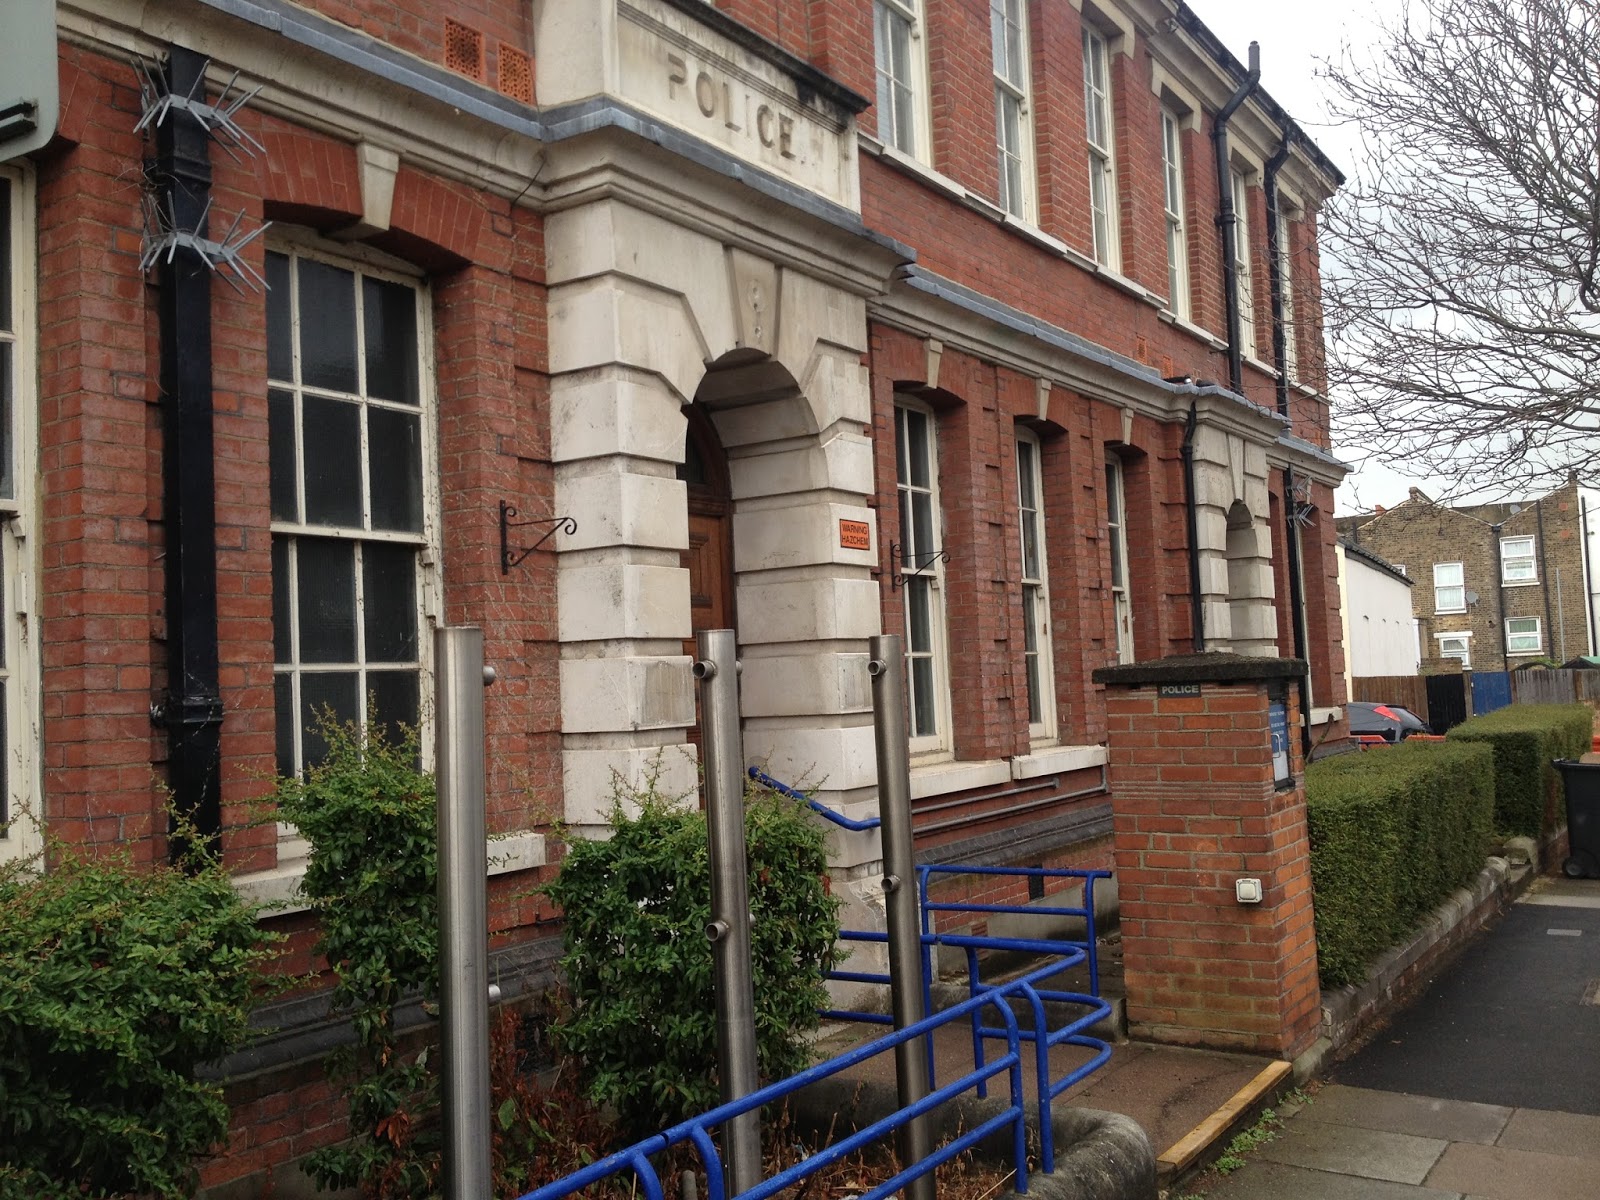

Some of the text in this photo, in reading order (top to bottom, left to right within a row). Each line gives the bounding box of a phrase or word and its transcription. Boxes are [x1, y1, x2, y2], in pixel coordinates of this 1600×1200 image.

[667, 52, 796, 160] POLICE
[842, 523, 867, 535] WARNING
[842, 535, 869, 546] HAZCHEM
[1161, 684, 1199, 694] POLICE
